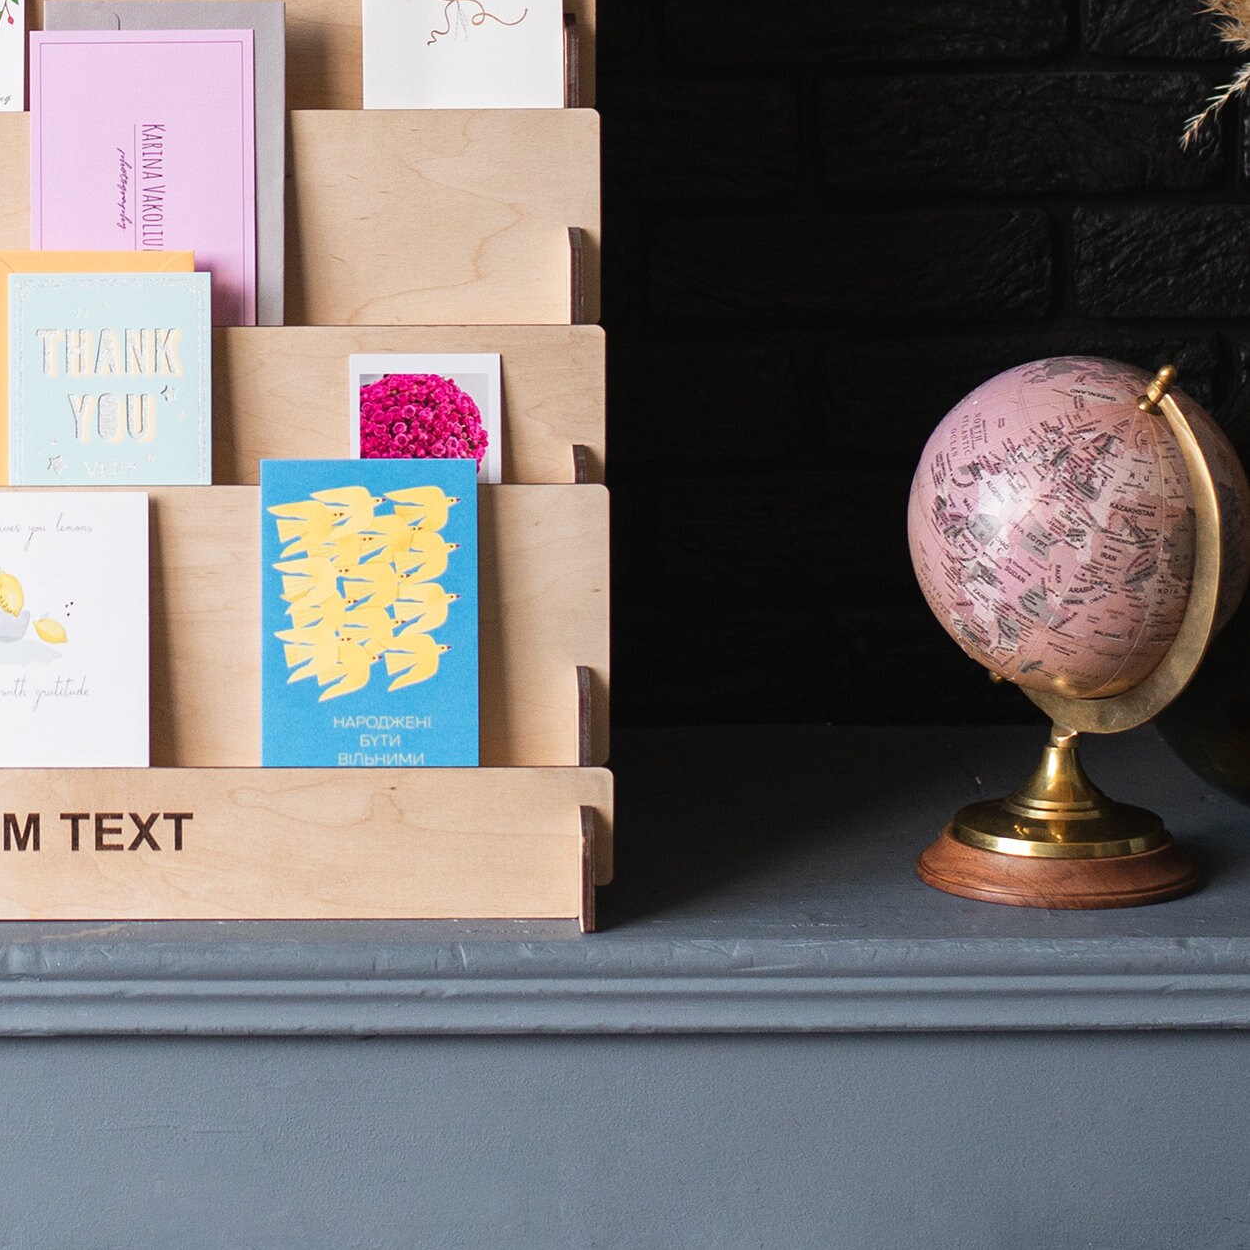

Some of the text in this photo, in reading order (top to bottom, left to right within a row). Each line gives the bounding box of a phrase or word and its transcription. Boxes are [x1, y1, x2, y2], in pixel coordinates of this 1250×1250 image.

[116, 147, 133, 230] photography
[141, 124, 166, 252] KARINA VAKOLIU
[35, 327, 185, 379] THANK
[1069, 388, 1117, 402] GREENLAND
[67, 393, 156, 444] YOU
[1109, 502, 1156, 518] KAZAKHSTAN
[1026, 531, 1048, 550] EGYPT
[1100, 551, 1118, 562] IRAN
[1004, 565, 1027, 584] SUDAN
[333, 715, 432, 730] НАРОДЖЕНІ
[359, 733, 402, 747] БУТИ
[337, 752, 426, 766] ВІЛЬНИМИ
[60, 812, 194, 852] TEXT
